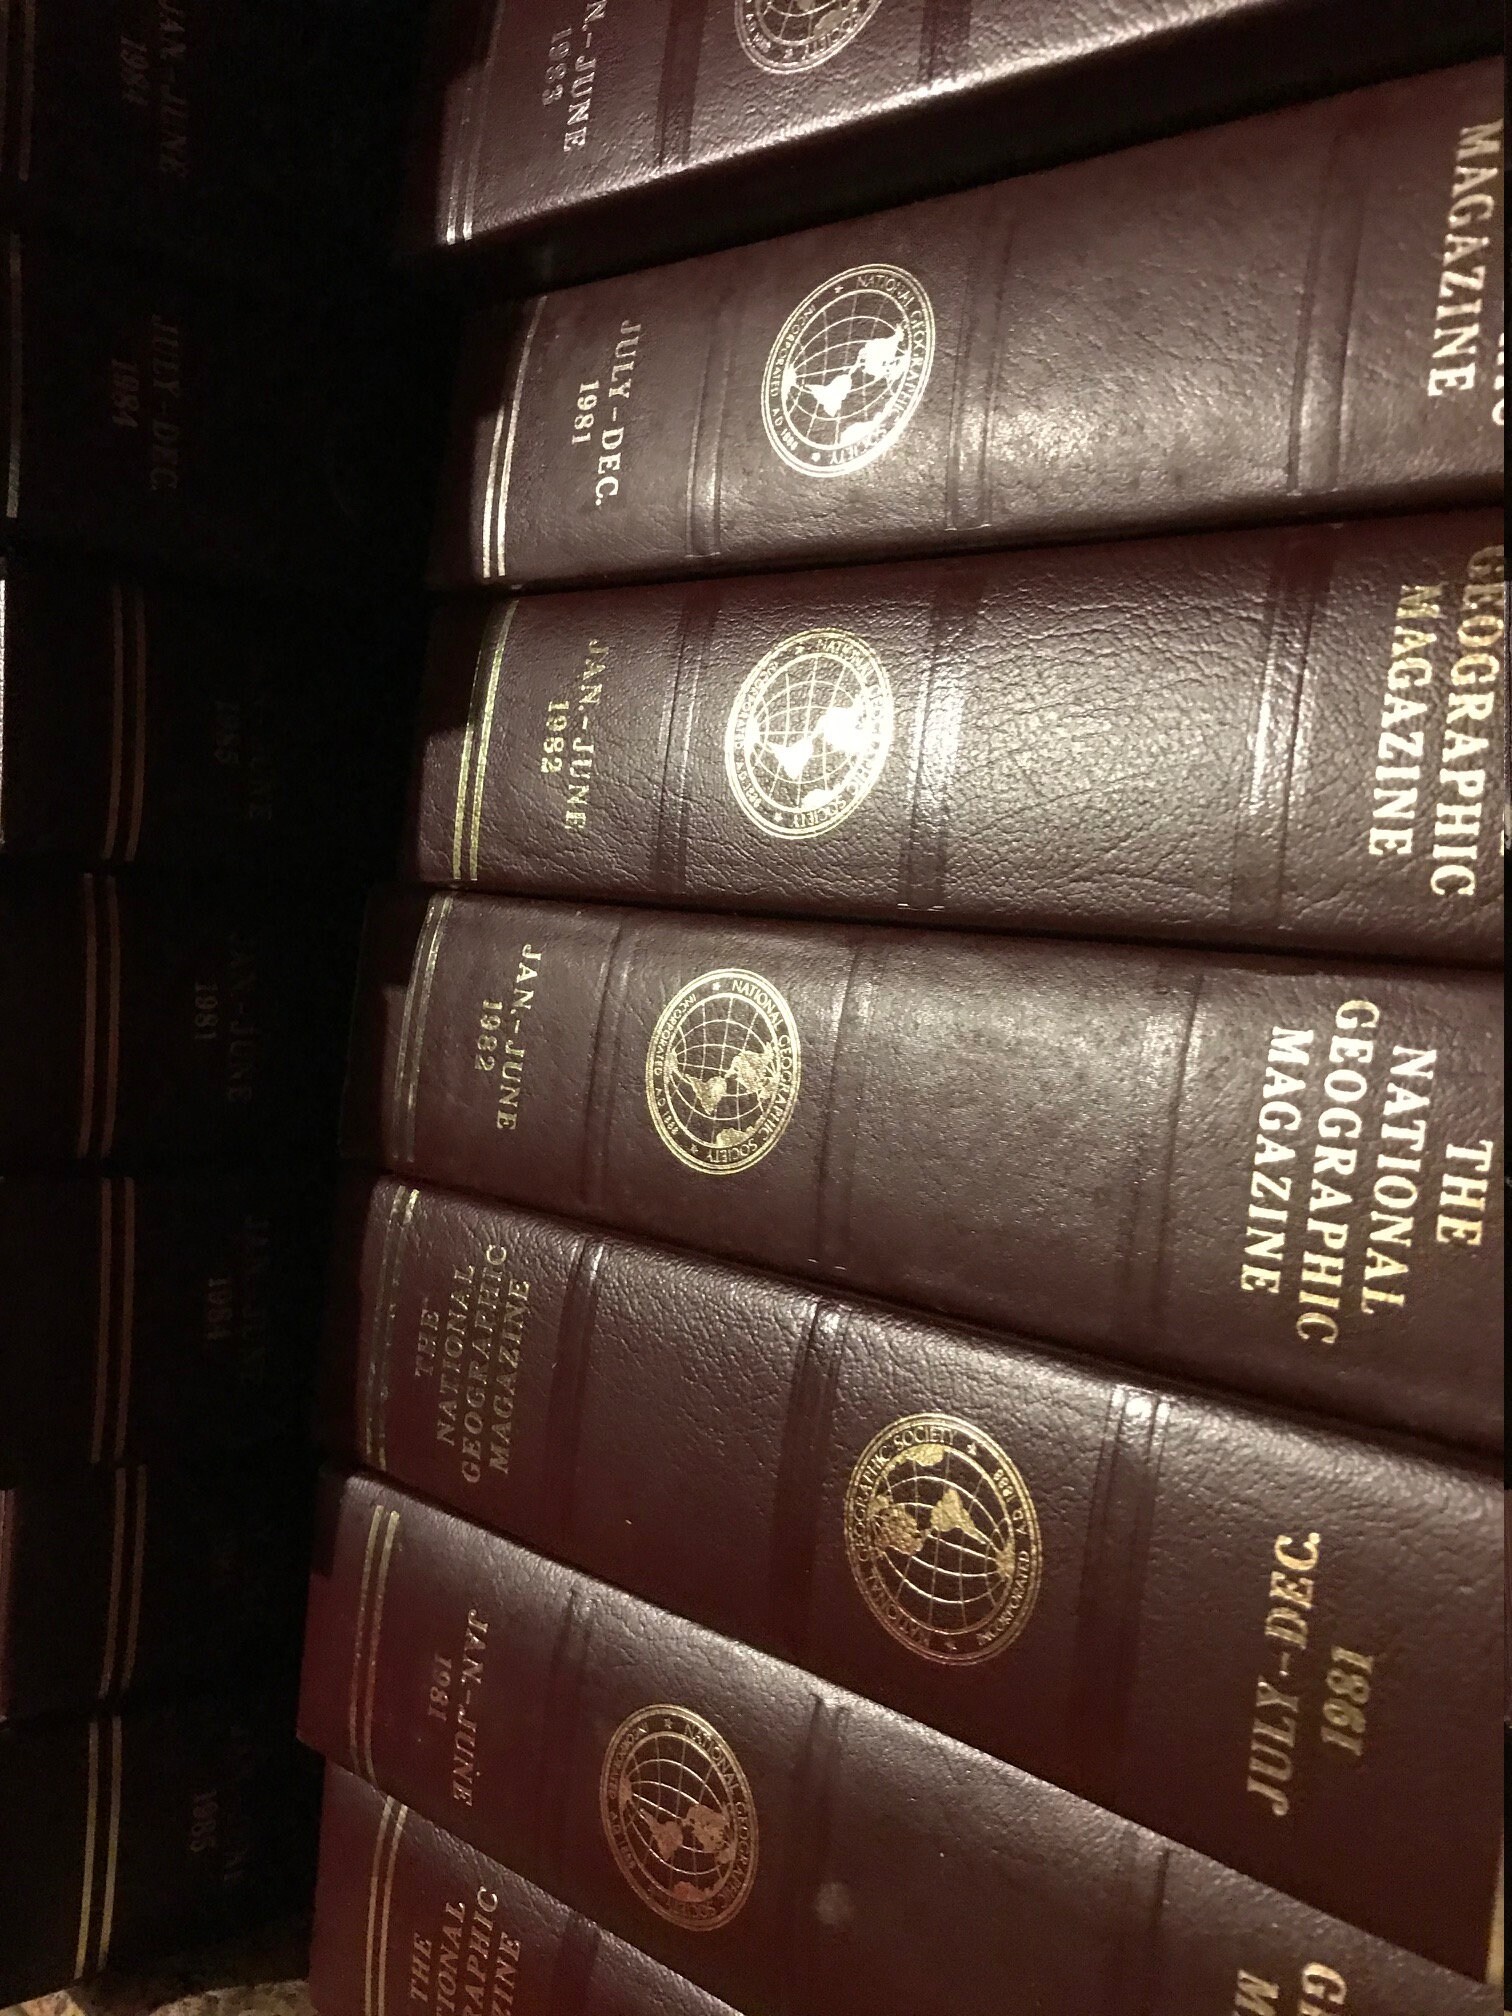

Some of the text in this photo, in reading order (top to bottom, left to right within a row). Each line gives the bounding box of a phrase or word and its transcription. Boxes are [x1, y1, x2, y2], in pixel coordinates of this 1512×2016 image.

[1427, 118, 1504, 397] MAGAZINE
[570, 379, 600, 446] 1981
[770, 304, 816, 397] INCORPORATED
[540, 701, 570, 774] 1982
[564, 639, 609, 830] JAN.-JUNE
[1369, 583, 1448, 857] MAGAZINE
[1430, 545, 1504, 897] GEOGRAPHIC
[474, 1000, 503, 1072] 1982
[495, 943, 542, 1131] JAN.-JUNE
[653, 993, 696, 1076] INCORPORATED
[705, 979, 793, 1164] NATIONAL GEOGRAPHIC SOCIETY
[1239, 1025, 1314, 1297] MAGAZINE
[1295, 1000, 1380, 1345] GEOGRAPHIC
[1360, 1045, 1437, 1315] NATIONAL
[1435, 1140, 1493, 1247] THE
[414, 1308, 439, 1376] THE
[436, 1264, 476, 1446] NATIONAL
[461, 1244, 507, 1483] GEOGRAPHIC
[489, 1278, 530, 1474] MAGAZINE
[854, 1445, 892, 1562] GEOGRAPHIC
[892, 1425, 955, 1452] SOCIETY
[427, 1653, 452, 1723] 1981
[451, 1609, 488, 1807] JAN.-JUNE
[1247, 1532, 1320, 1816] JULY-DEC.
[1320, 1645, 1374, 1756] 1981
[410, 1932, 432, 2003] THE
